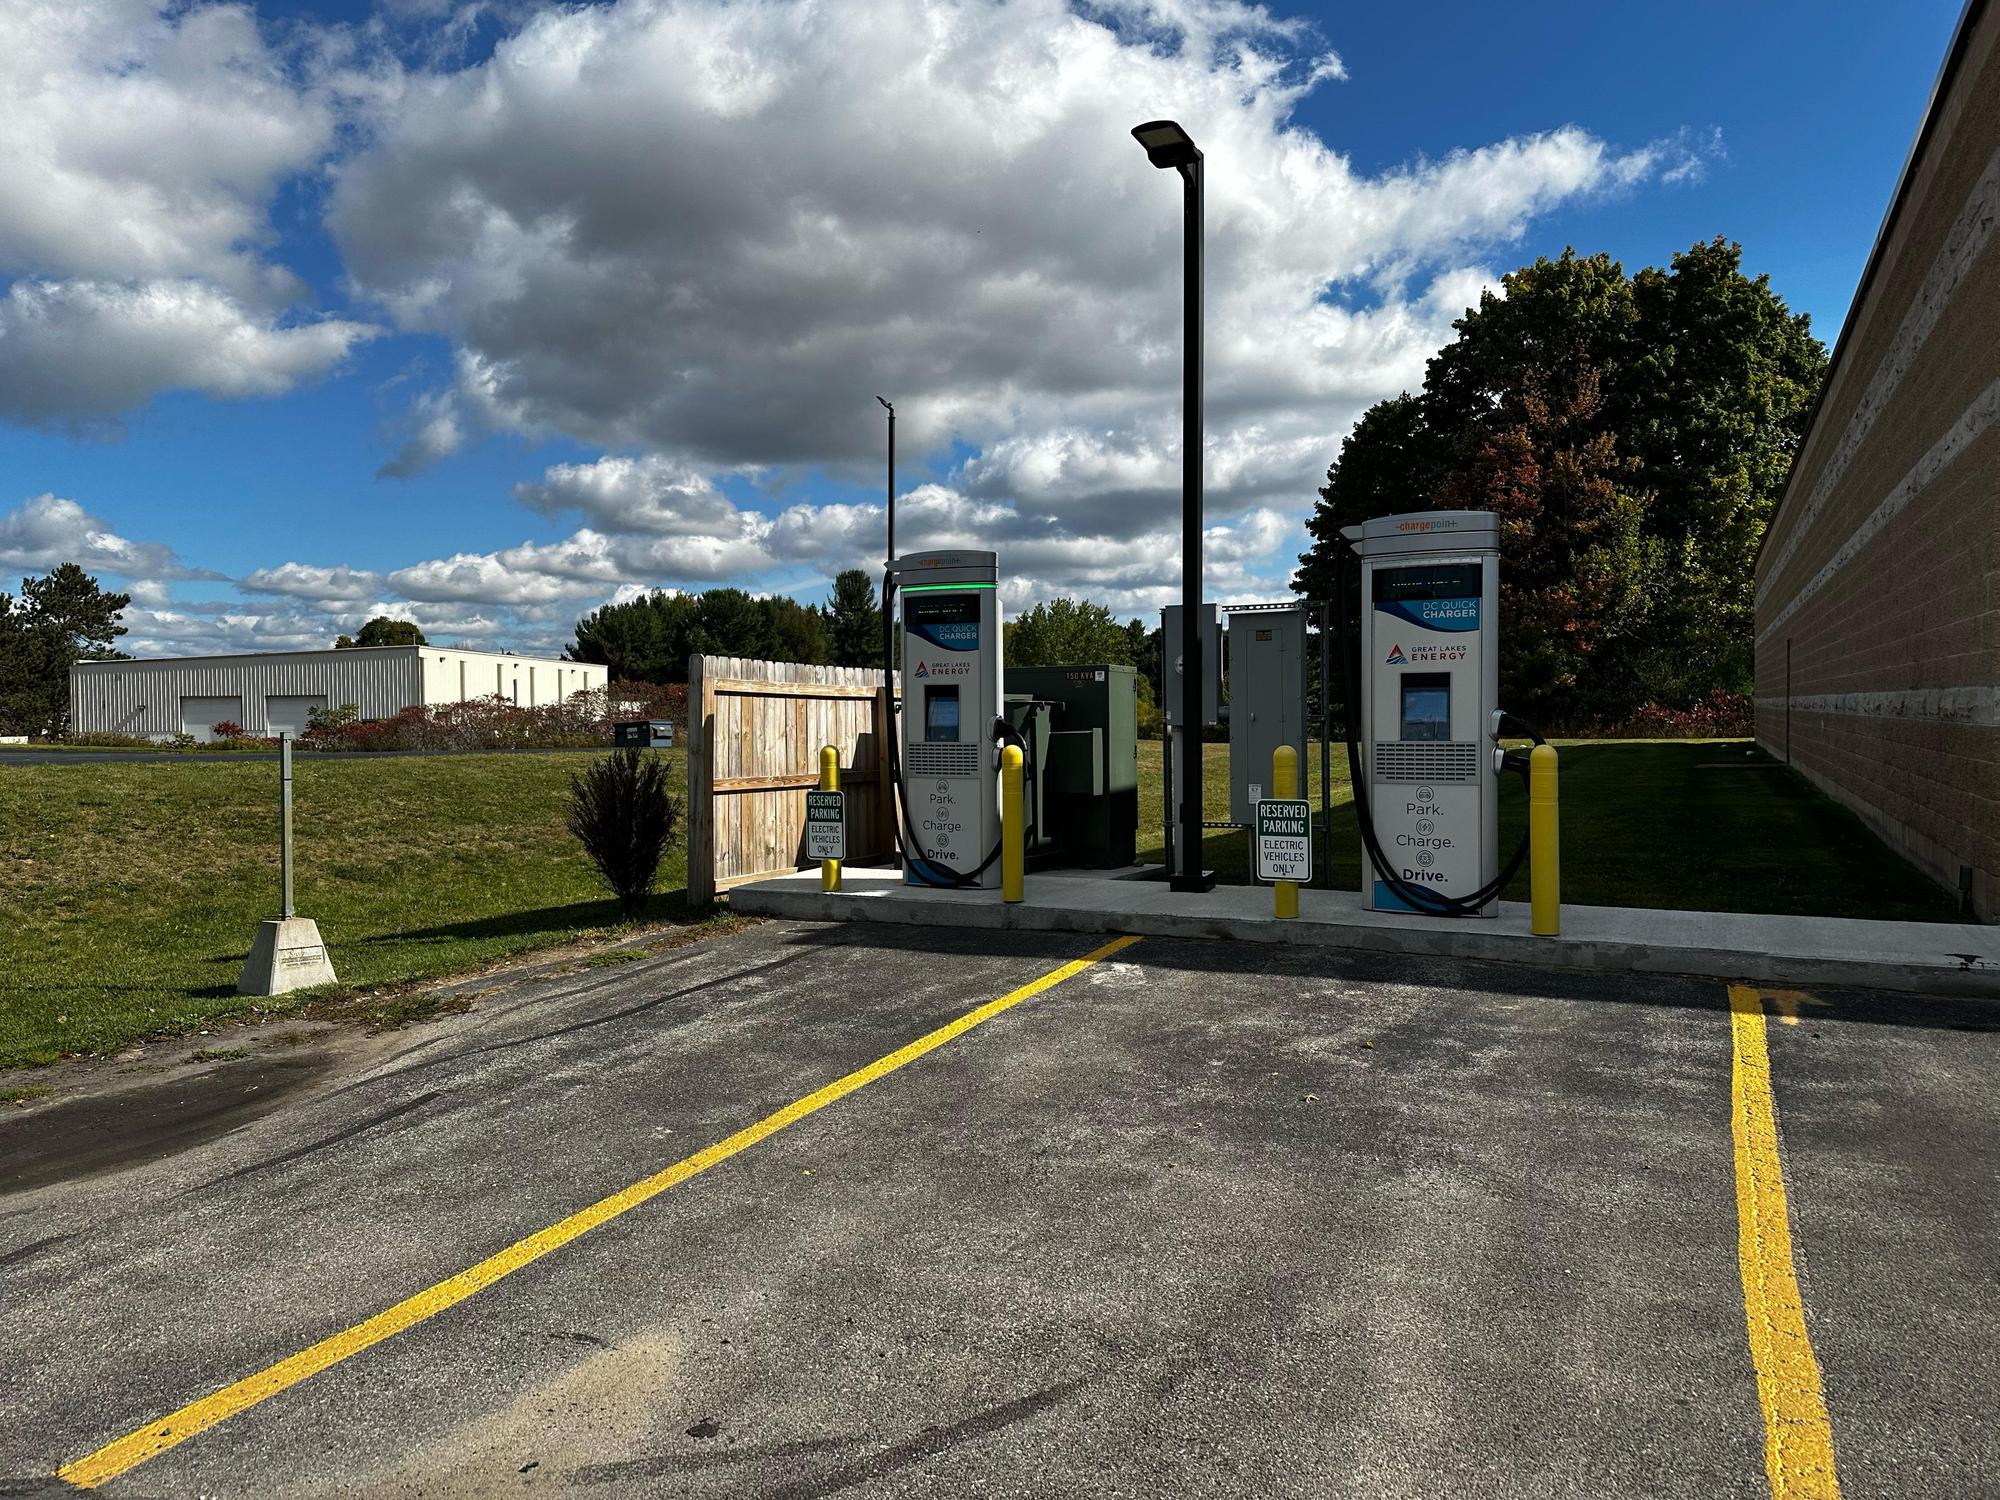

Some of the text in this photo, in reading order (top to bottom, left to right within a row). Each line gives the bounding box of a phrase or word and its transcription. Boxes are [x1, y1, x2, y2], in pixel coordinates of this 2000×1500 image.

[1423, 600, 1476, 610] DC QUICK
[1423, 609, 1476, 619] CHARGER
[939, 624, 977, 633] DC QUICK
[939, 632, 977, 640] CHARGER
[1411, 652, 1466, 661] ENERGY
[808, 795, 841, 806] RESERVED
[930, 793, 956, 804] Park.
[810, 808, 840, 819] PARKING
[1260, 804, 1307, 818] RESERVED
[1406, 803, 1444, 816] Park.
[811, 825, 839, 834] ELECTRIC
[1263, 820, 1304, 833] PARKING
[811, 835, 840, 844] VEHICLES
[1396, 834, 1455, 849] Charge.
[817, 845, 834, 854] ONLY
[1264, 840, 1304, 850] ELECTRIC
[927, 849, 959, 860] Drive.
[1263, 851, 1305, 862] VEHICLES
[1272, 863, 1296, 873] ONLY
[1403, 868, 1448, 882] Drive.
